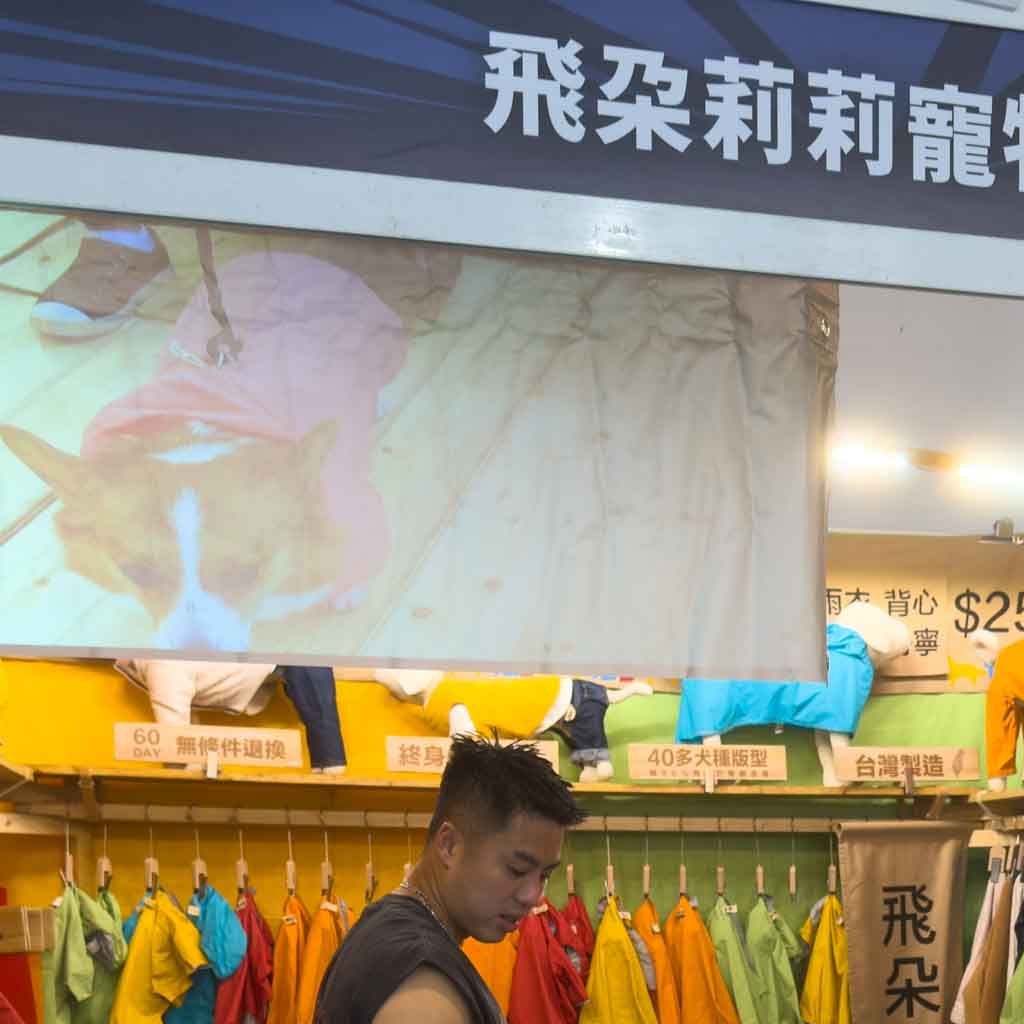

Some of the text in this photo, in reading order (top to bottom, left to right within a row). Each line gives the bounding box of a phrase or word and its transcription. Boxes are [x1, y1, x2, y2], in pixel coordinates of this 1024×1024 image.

[885, 589, 938, 617] 背心
[133, 728, 161, 746] 60
[176, 735, 287, 760] 無條件退換
[133, 748, 161, 759] DAY
[399, 743, 446, 768] 終身
[648, 748, 768, 767] 40多犬種版型
[855, 754, 945, 778] 台灣製造
